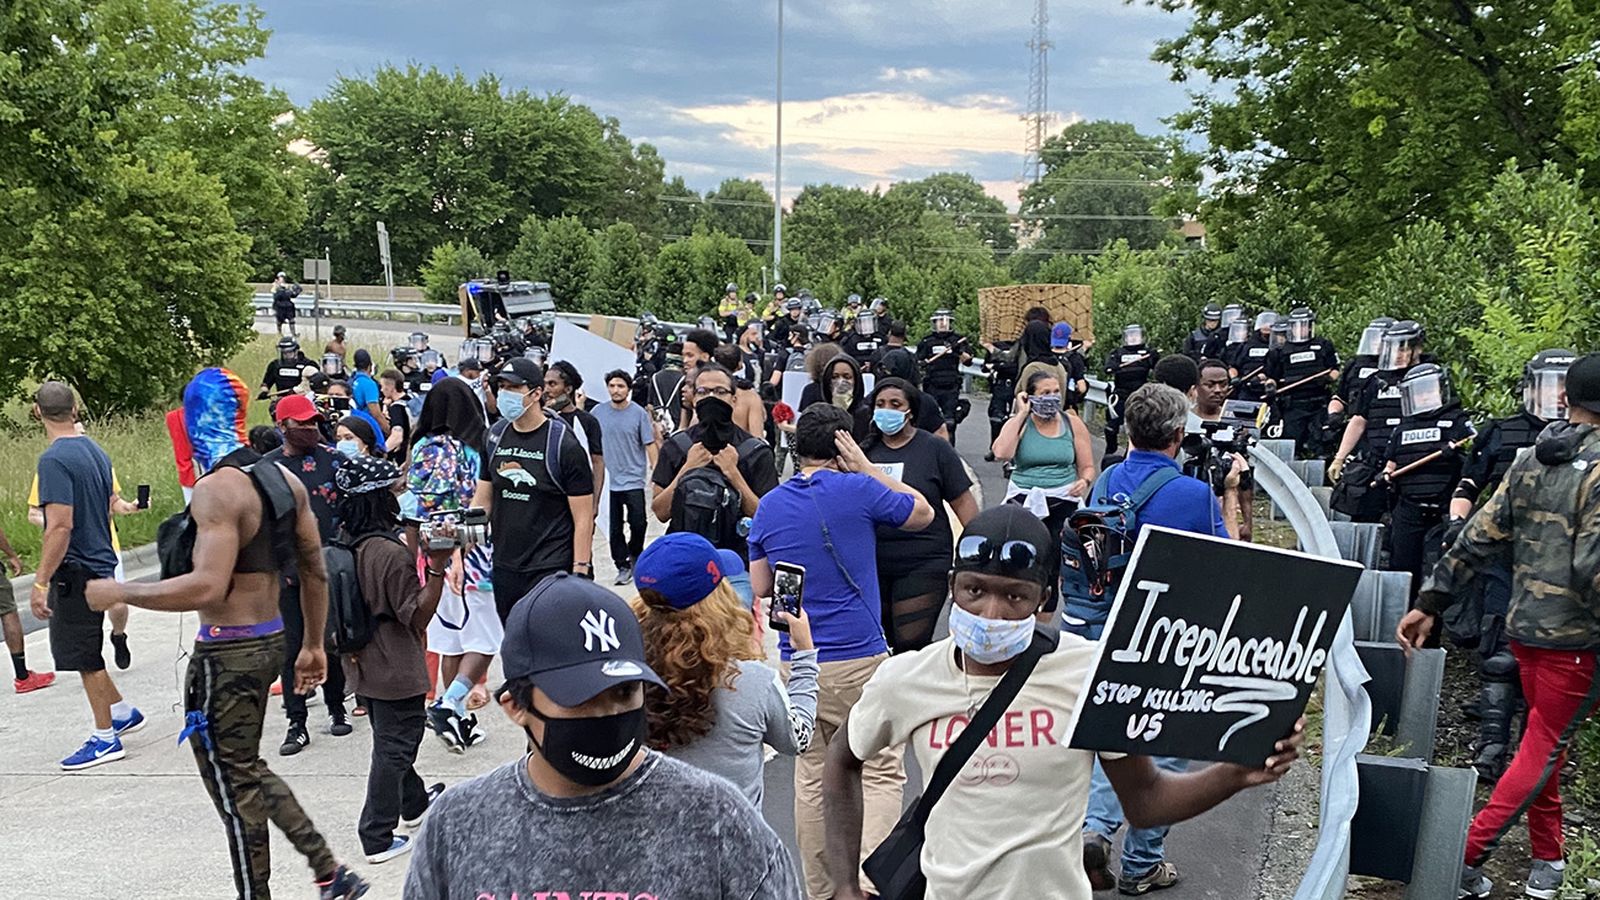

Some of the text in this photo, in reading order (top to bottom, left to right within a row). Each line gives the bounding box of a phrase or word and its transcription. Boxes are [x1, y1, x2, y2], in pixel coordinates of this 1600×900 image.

[1404, 429, 1439, 442] POLICE
[513, 447, 544, 460] Lincoln
[1111, 580, 1327, 688] Irreplaceable
[1093, 680, 1215, 713] STOP KILLING
[1126, 712, 1166, 743] US
